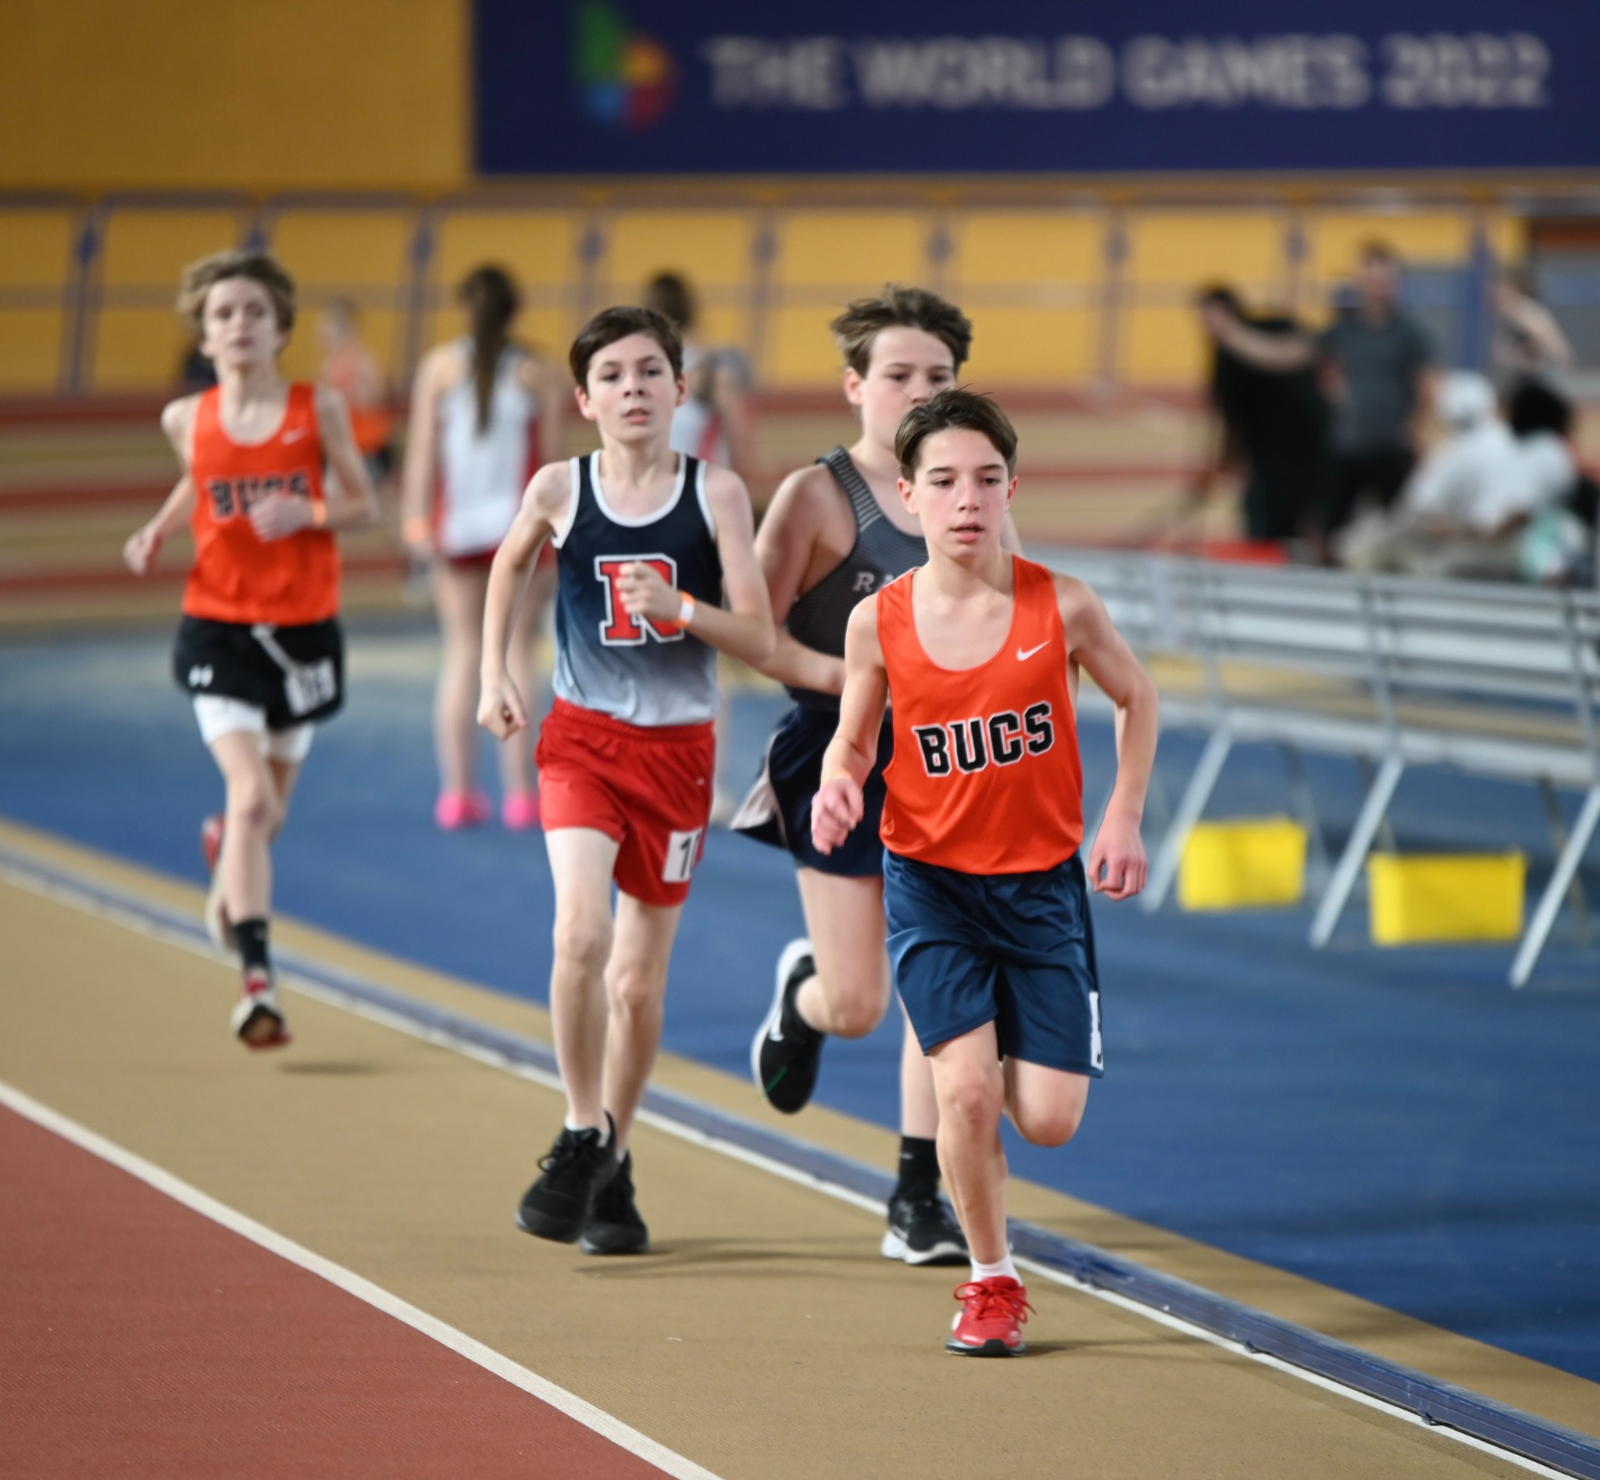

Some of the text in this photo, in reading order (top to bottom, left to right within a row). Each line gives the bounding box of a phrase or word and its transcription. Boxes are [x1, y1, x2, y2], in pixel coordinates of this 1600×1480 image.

[705, 34, 1551, 108] THE WORLD GAMES 2022
[594, 554, 684, 646] R
[912, 700, 1055, 777] BUCS
